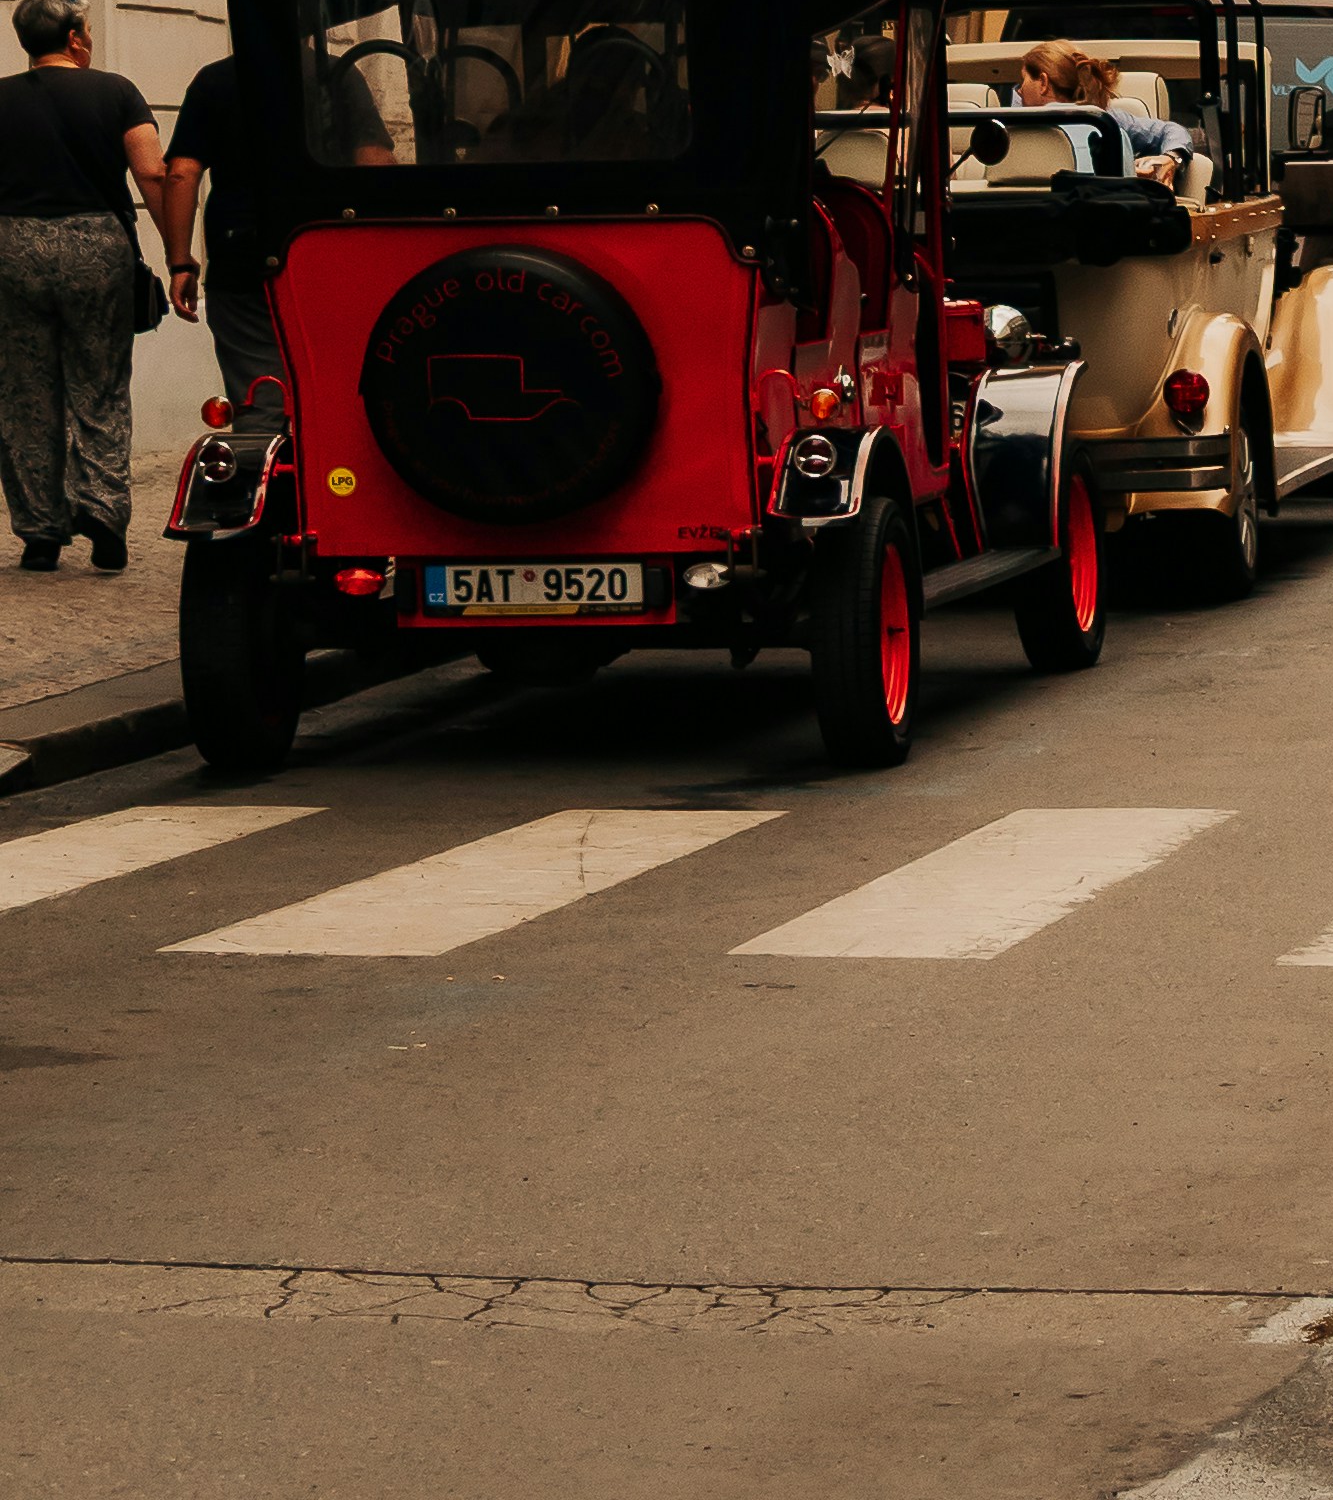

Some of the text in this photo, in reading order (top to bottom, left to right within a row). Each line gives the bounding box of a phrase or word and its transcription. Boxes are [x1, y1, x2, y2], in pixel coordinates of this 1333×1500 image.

[475, 268, 526, 293] old
[331, 476, 354, 486] LPG
[453, 568, 628, 602] 5AT 9520
[429, 593, 445, 603] CZ
